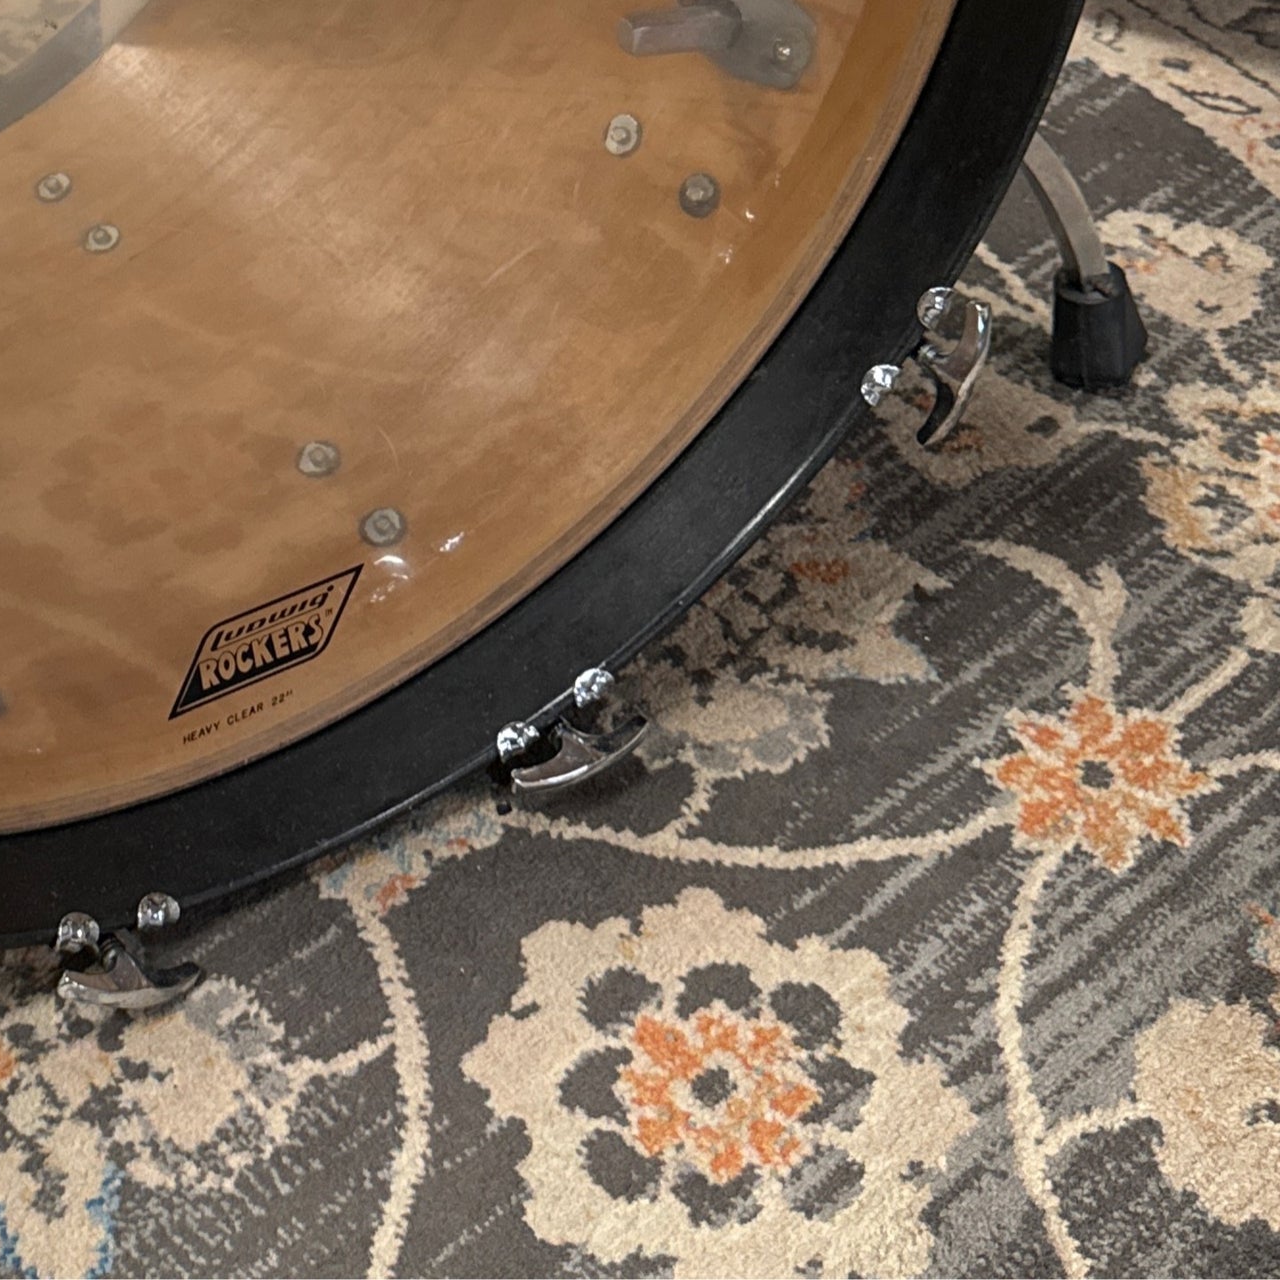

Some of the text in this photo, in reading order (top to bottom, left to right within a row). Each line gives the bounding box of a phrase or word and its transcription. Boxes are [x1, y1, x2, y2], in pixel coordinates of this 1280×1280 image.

[198, 613, 324, 691] ROCKERS
[182, 721, 220, 744] HEAVY
[227, 701, 264, 725] CLEAR
